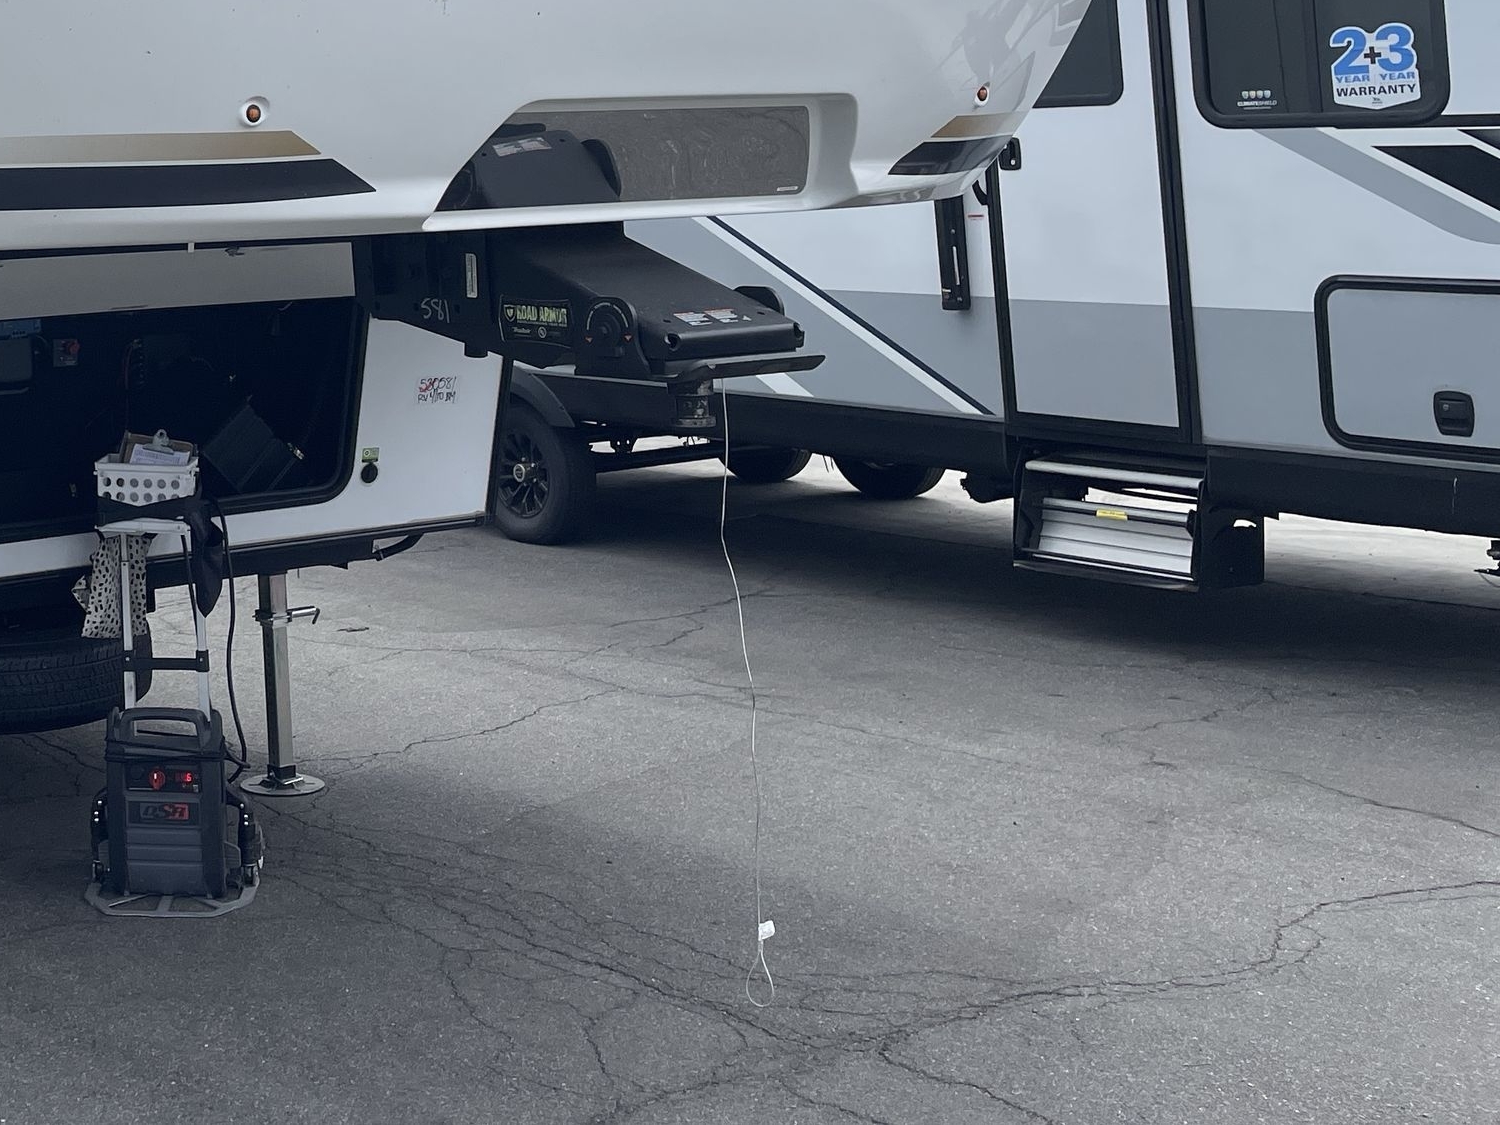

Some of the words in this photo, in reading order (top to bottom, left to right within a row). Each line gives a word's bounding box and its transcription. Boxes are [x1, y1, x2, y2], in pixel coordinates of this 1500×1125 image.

[1335, 75, 1370, 84] YEAR
[1379, 71, 1416, 80] YEAR
[1336, 83, 1417, 97] WARRANTY
[420, 297, 451, 324] 581
[517, 305, 538, 321] ROAD
